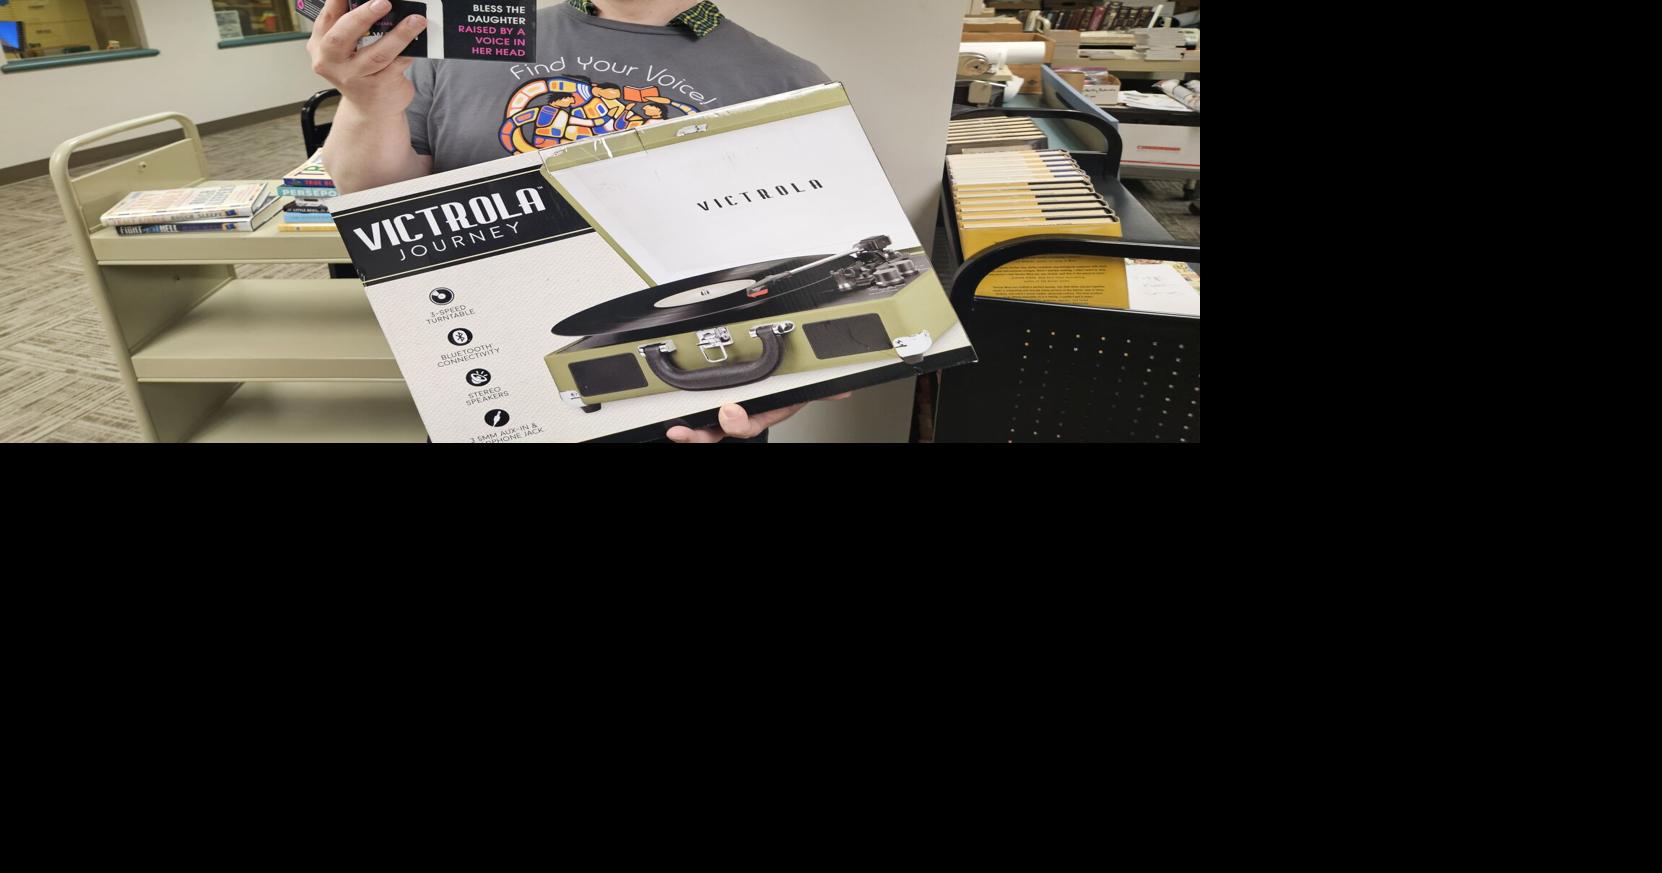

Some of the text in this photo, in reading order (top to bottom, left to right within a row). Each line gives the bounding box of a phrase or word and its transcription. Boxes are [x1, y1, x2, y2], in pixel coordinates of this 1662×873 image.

[473, 4, 526, 14] BLESS THE
[467, 14, 526, 25] DAUGHTER
[458, 25, 497, 34] RAISED
[500, 27, 513, 35] BY
[475, 36, 526, 46] VOICE IN
[472, 47, 526, 57] HER HEAD
[510, 56, 718, 105] Find Your Voice!
[697, 179, 823, 211] VICTROLA
[400, 221, 520, 262] JOURNEY
[425, 308, 476, 325] TURNTABLE
[430, 304, 467, 318] 3-SPEED
[437, 347, 500, 368] CONNECTIVITY
[440, 343, 492, 361] BLUETOOTH
[465, 390, 510, 406] SPEAKERS
[467, 386, 502, 399] STEREO
[500, 424, 529, 436] AUX-IN
[524, 427, 545, 438] JACK
